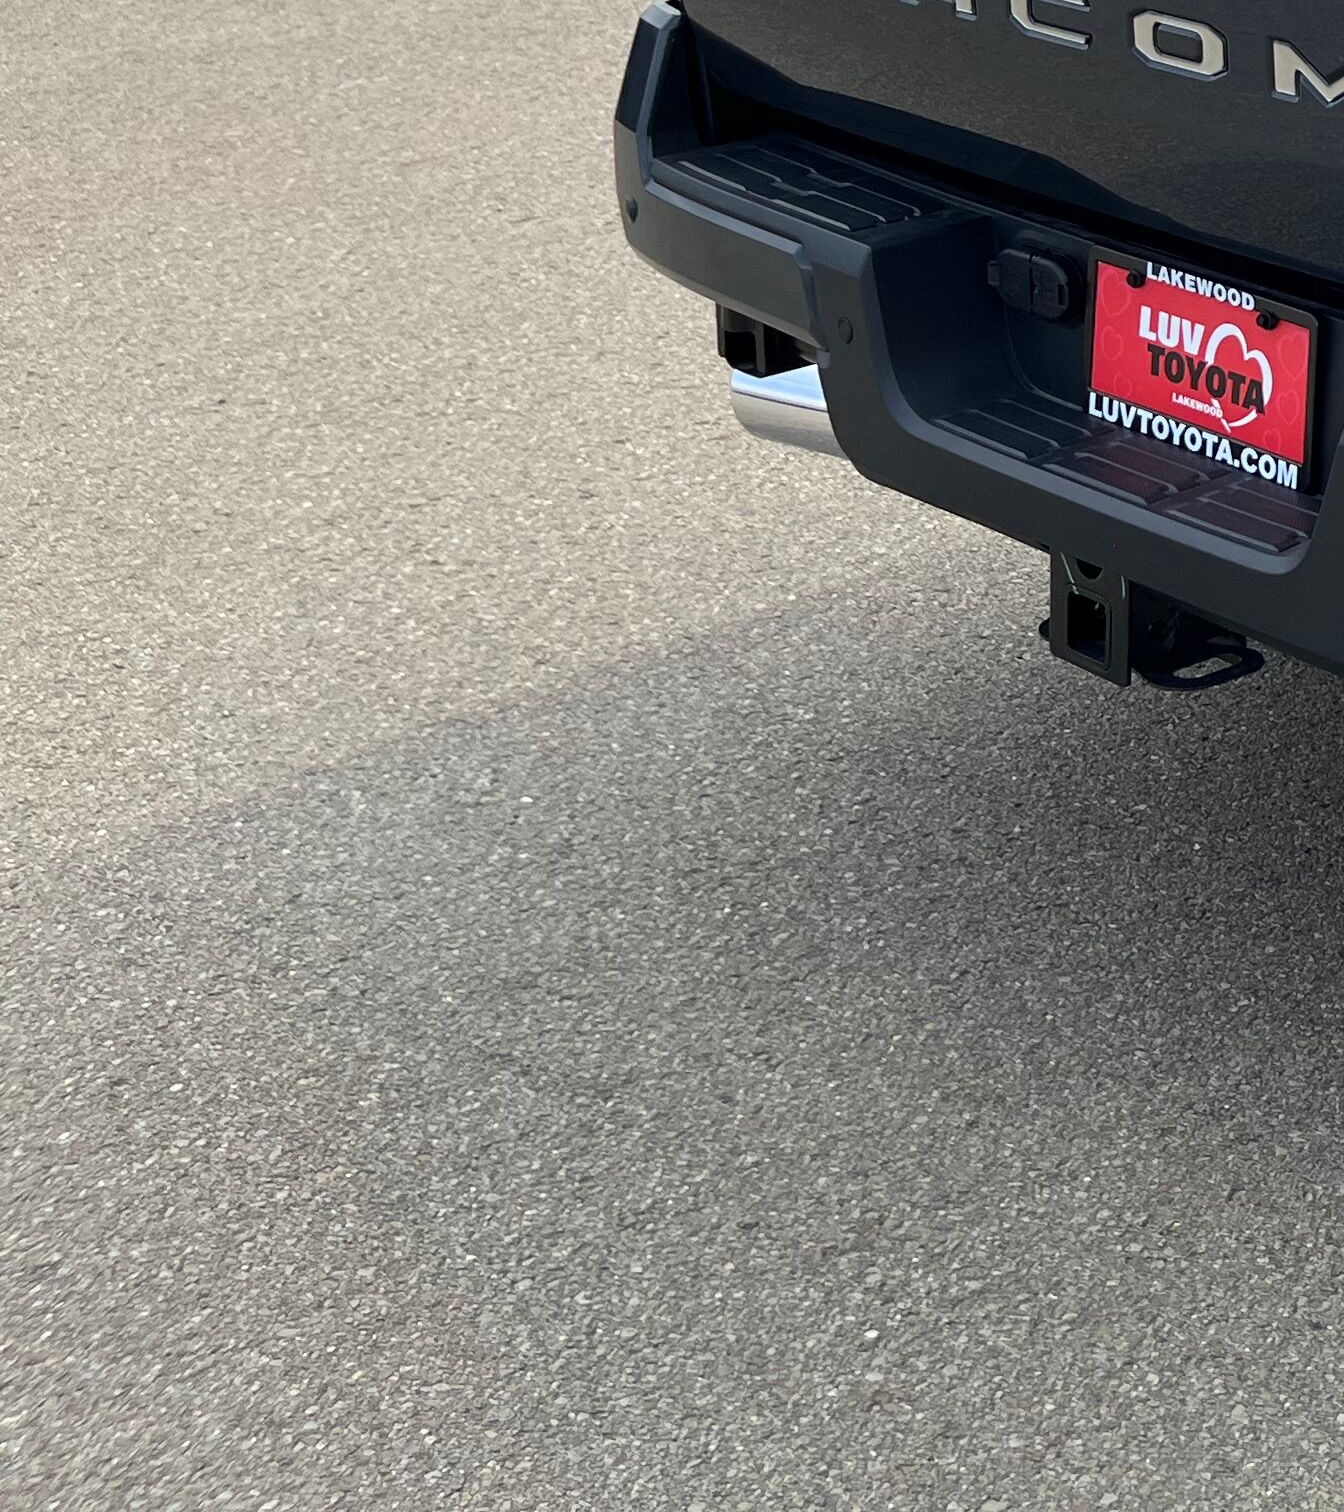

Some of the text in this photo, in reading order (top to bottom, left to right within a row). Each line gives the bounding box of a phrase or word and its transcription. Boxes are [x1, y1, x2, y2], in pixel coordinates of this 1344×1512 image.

[1145, 261, 1256, 312] LAKEWOOD
[1138, 304, 1206, 357] LUV
[1147, 342, 1266, 415] TOYOTA
[1171, 391, 1224, 420] LAKEWOOD
[1087, 390, 1299, 491] LUVTOYOTA.COM
